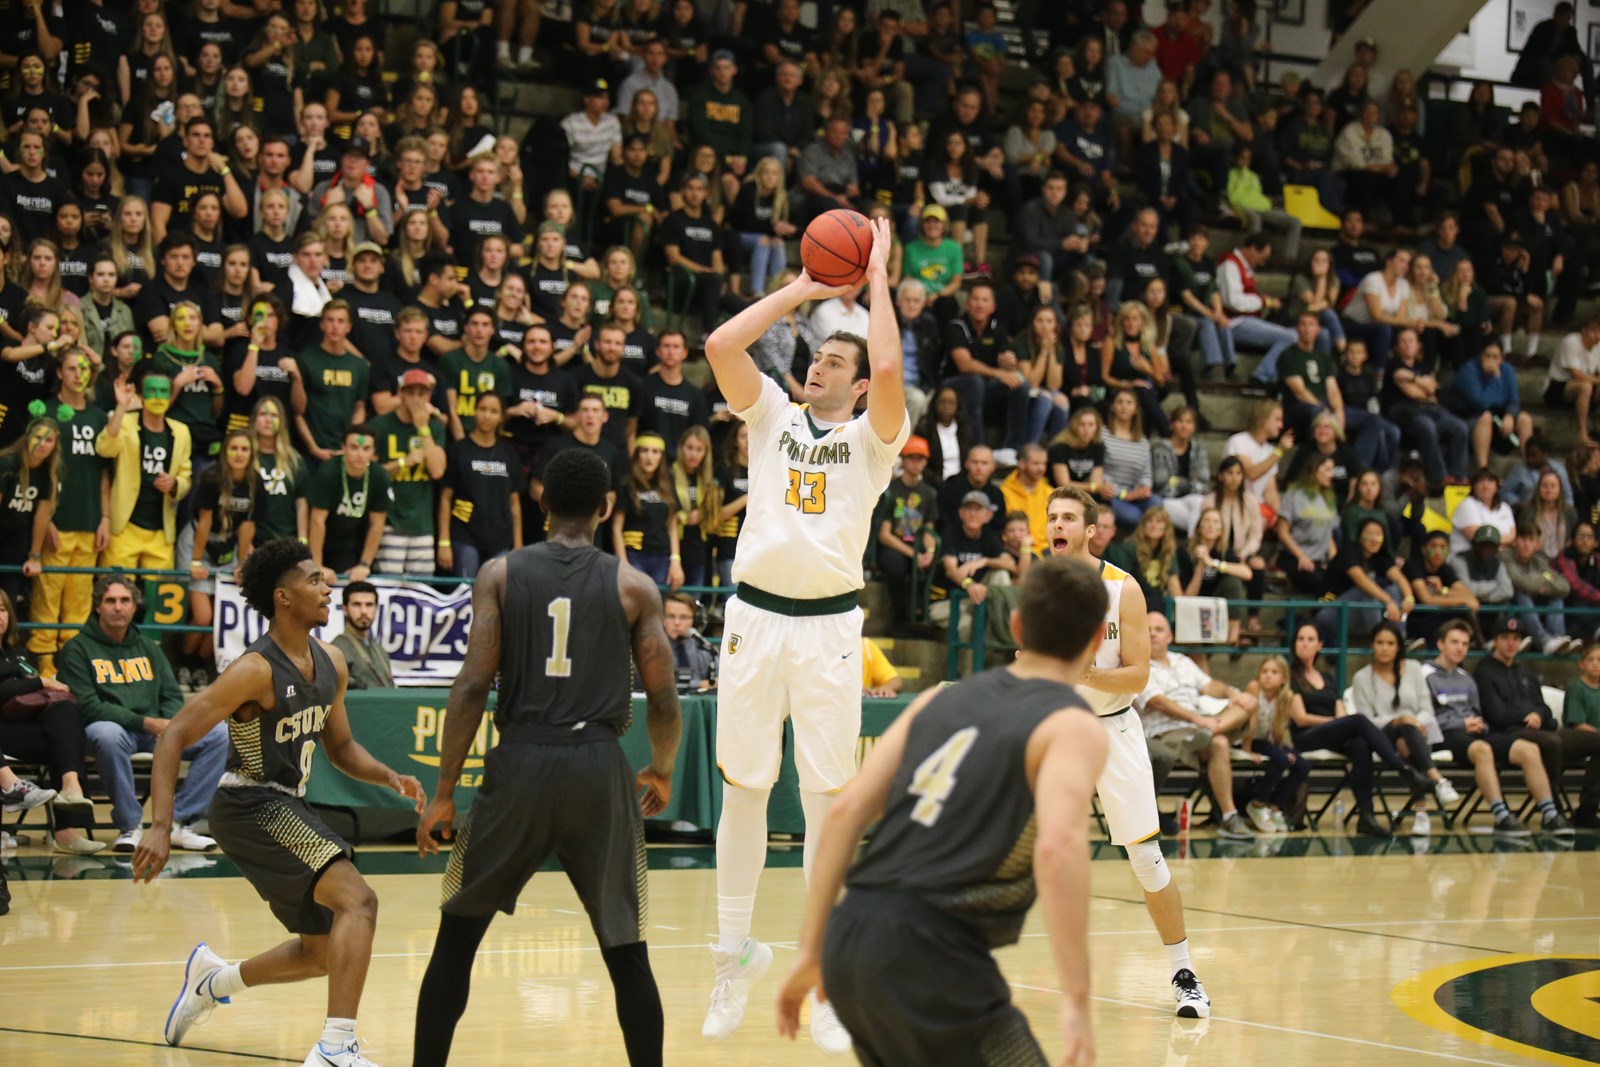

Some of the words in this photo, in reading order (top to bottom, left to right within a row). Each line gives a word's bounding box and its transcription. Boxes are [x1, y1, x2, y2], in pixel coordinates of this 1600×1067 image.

[72, 424, 95, 440] LO
[72, 440, 96, 456] MA
[144, 445, 167, 460] LO
[779, 431, 810, 462] PNT
[809, 442, 851, 466] LOMA
[8, 498, 33, 512] MA
[15, 484, 38, 499] LO
[154, 583, 185, 624] 3
[546, 597, 571, 677] 1
[92, 656, 154, 684] PLNU
[411, 706, 500, 756] PNT
[300, 740, 316, 784] 0
[908, 726, 979, 827] 4
